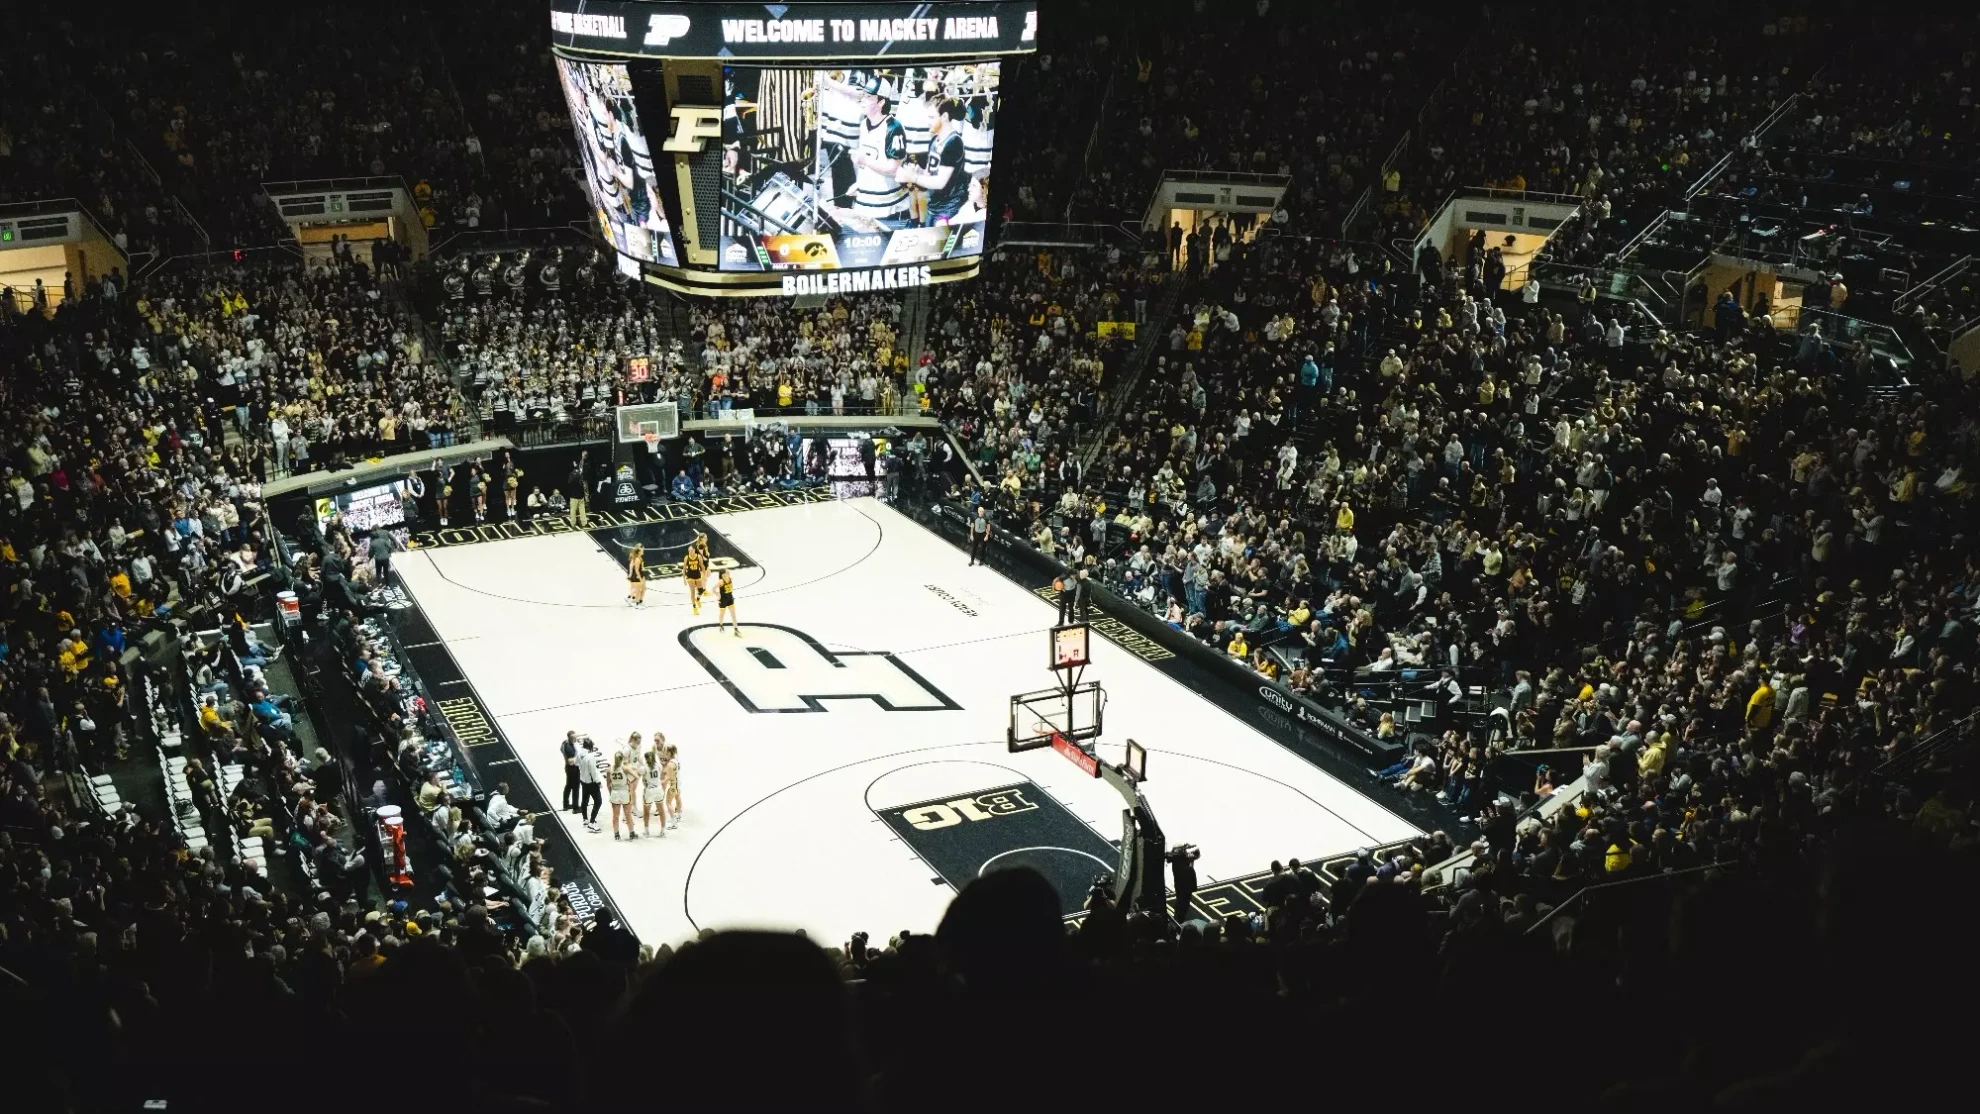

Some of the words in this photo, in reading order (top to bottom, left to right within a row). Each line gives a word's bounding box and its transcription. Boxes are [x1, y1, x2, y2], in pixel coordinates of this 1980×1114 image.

[721, 19, 824, 42] WELCOME
[830, 19, 855, 42] TO
[860, 18, 938, 41] MACKEY
[944, 16, 998, 39] ARENA
[844, 236, 881, 248] 10:00
[783, 265, 931, 296] BOILERMAKERS
[631, 365, 647, 380] 30
[615, 495, 640, 503] PIONEER
[436, 697, 499, 747] PURDUE
[566, 882, 595, 919] PURDUE
